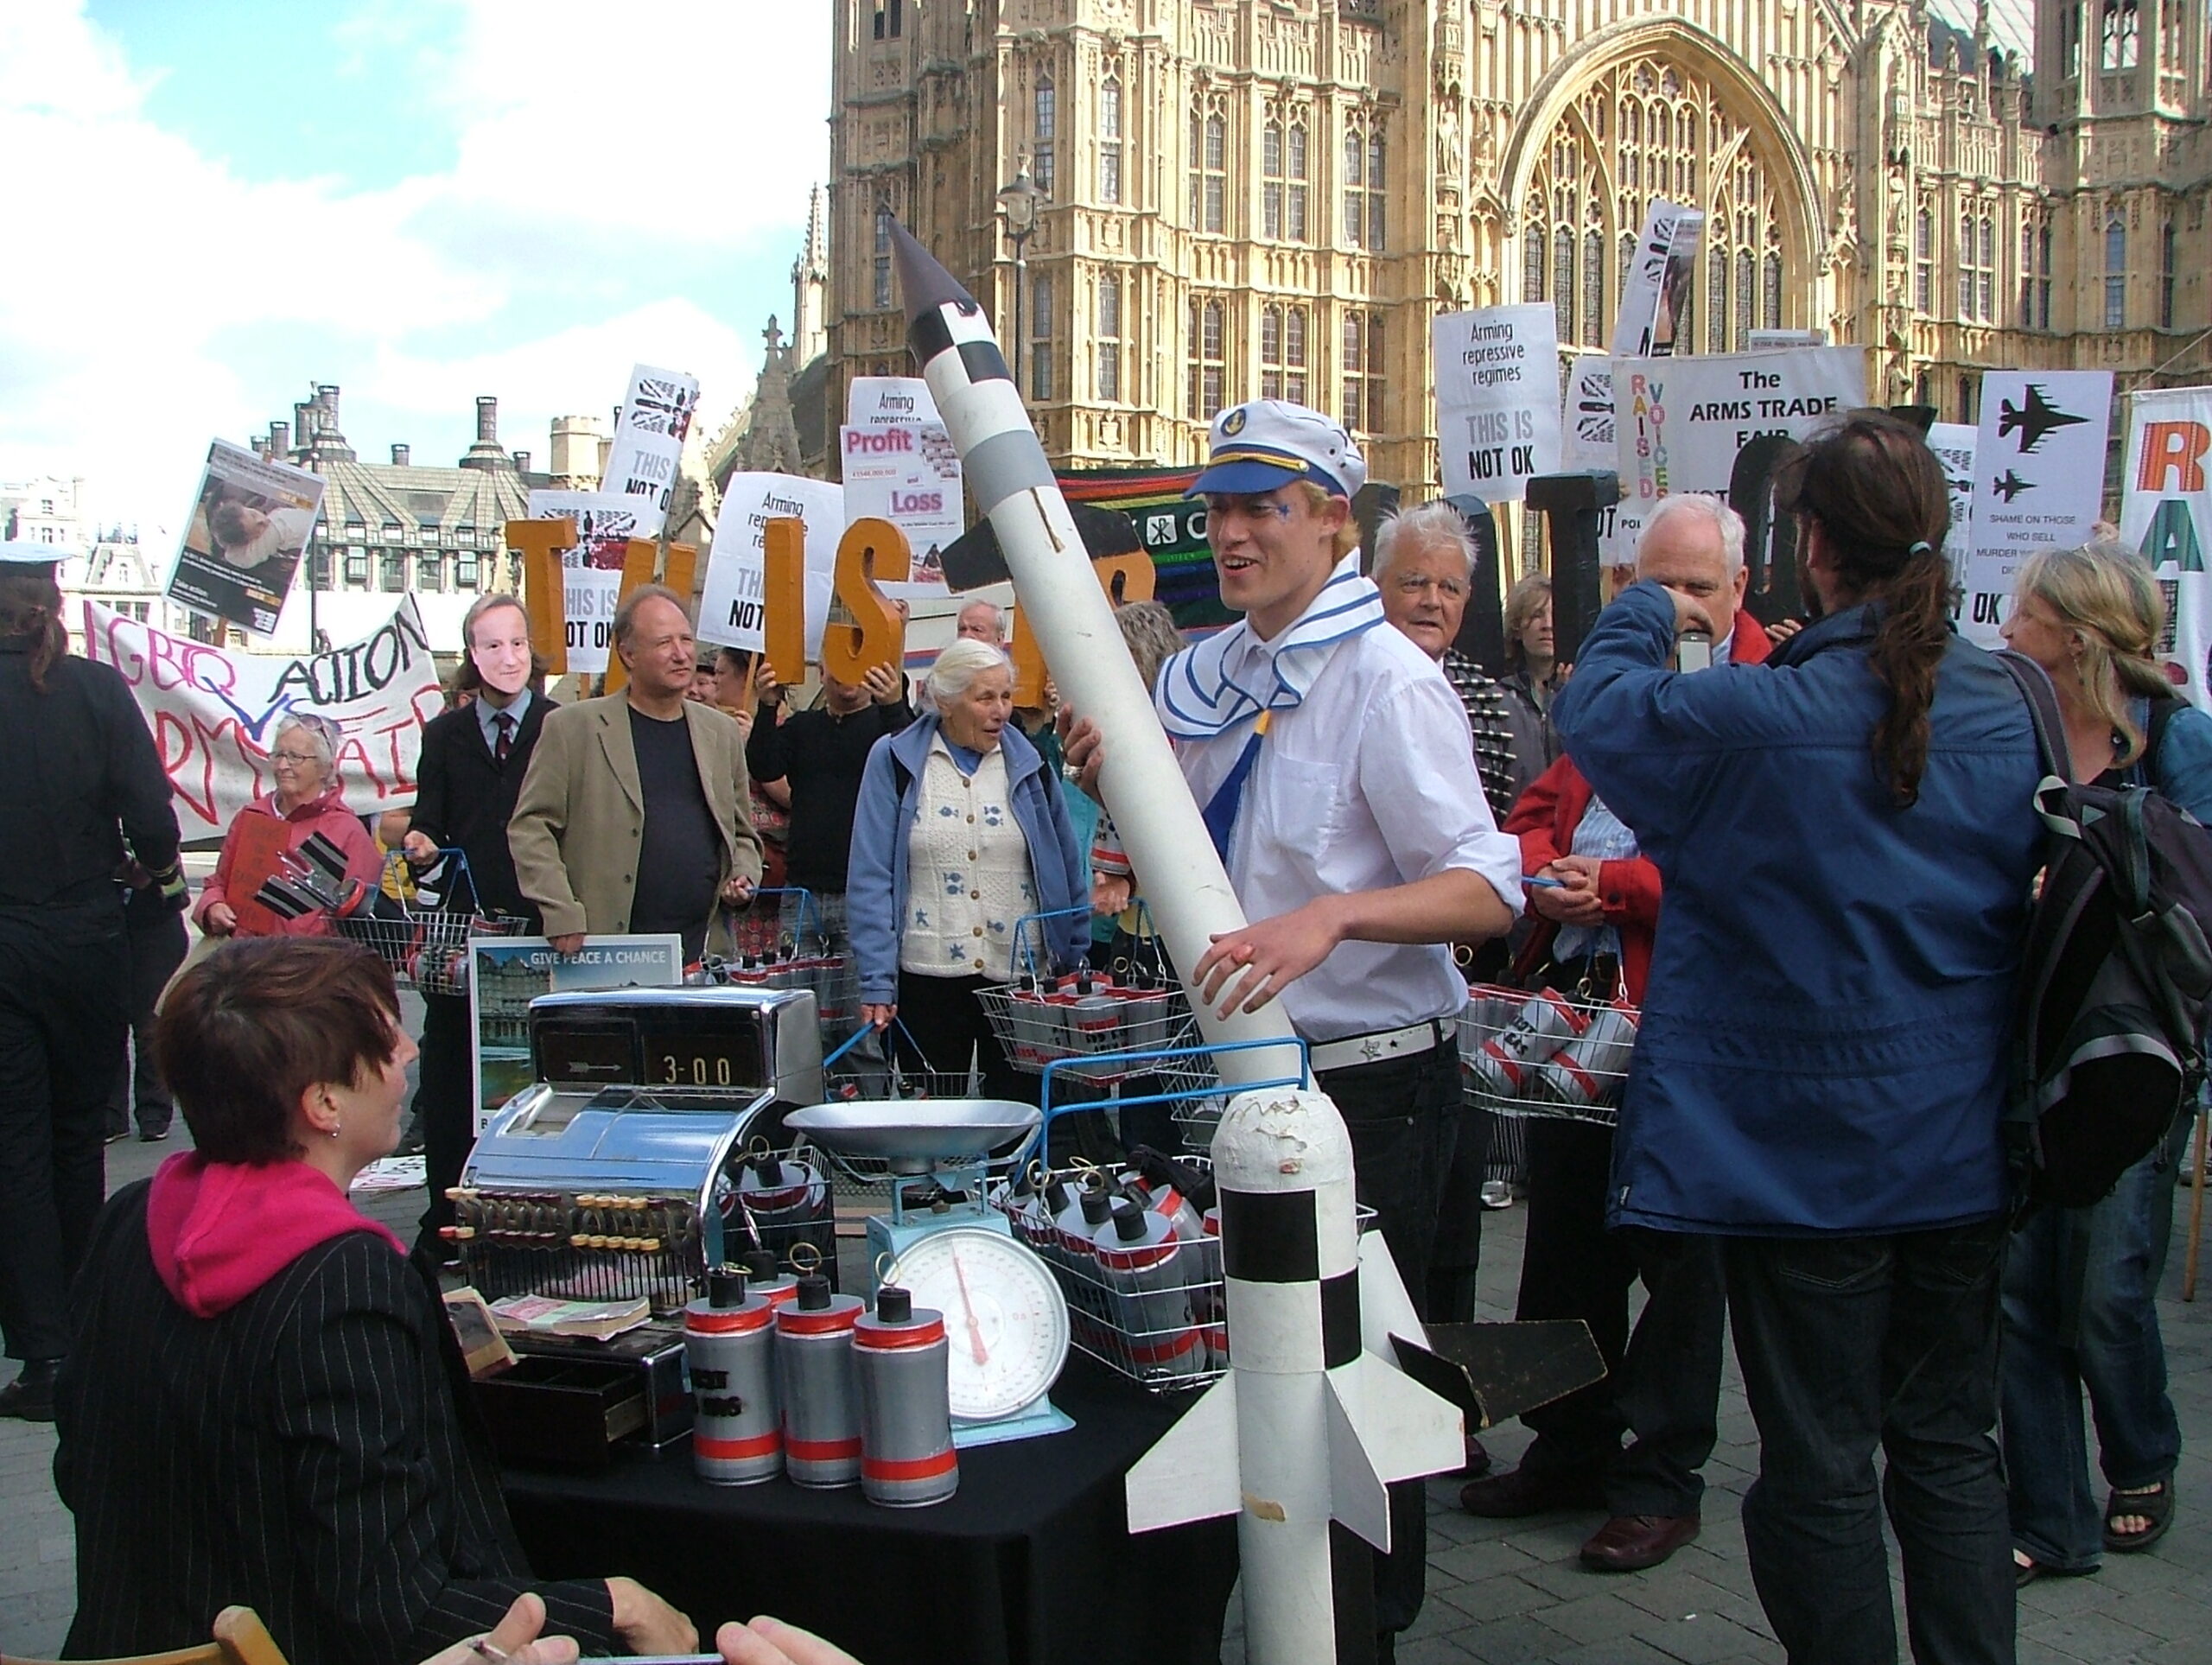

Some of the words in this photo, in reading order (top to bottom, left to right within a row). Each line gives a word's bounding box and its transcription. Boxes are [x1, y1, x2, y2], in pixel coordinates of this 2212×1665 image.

[1471, 320, 1512, 343] Arming
[1463, 345, 1524, 366] repressive
[1472, 364, 1521, 387] regimes
[1739, 372, 1780, 390] The
[879, 391, 914, 414] Arming
[1689, 400, 1751, 422] ARMS
[1758, 397, 1838, 418] TRADE
[1465, 411, 1508, 444] THIS
[1515, 410, 1534, 440] IS
[846, 428, 912, 454] Profit
[632, 449, 671, 480] THIS
[1469, 448, 1503, 480] NOT
[1511, 444, 1535, 475] OK
[761, 491, 804, 518] Arming
[892, 491, 943, 512] Loss
[1990, 514, 2023, 524] SHAME
[2025, 515, 2040, 524] ON
[2044, 516, 2075, 524] THOSE
[2006, 532, 2029, 541] WHO
[2031, 532, 2056, 542] SELL
[1976, 549, 2017, 557] MURDER
[738, 568, 764, 599] TH
[566, 588, 594, 616] HIS
[601, 590, 617, 616] IS
[1972, 593, 2002, 625] OK
[566, 621, 588, 647] OT
[268, 610, 433, 705] ACTION
[531, 952, 560, 965] GIVE
[604, 951, 613, 964] A
[615, 950, 666, 964] CHANCE
